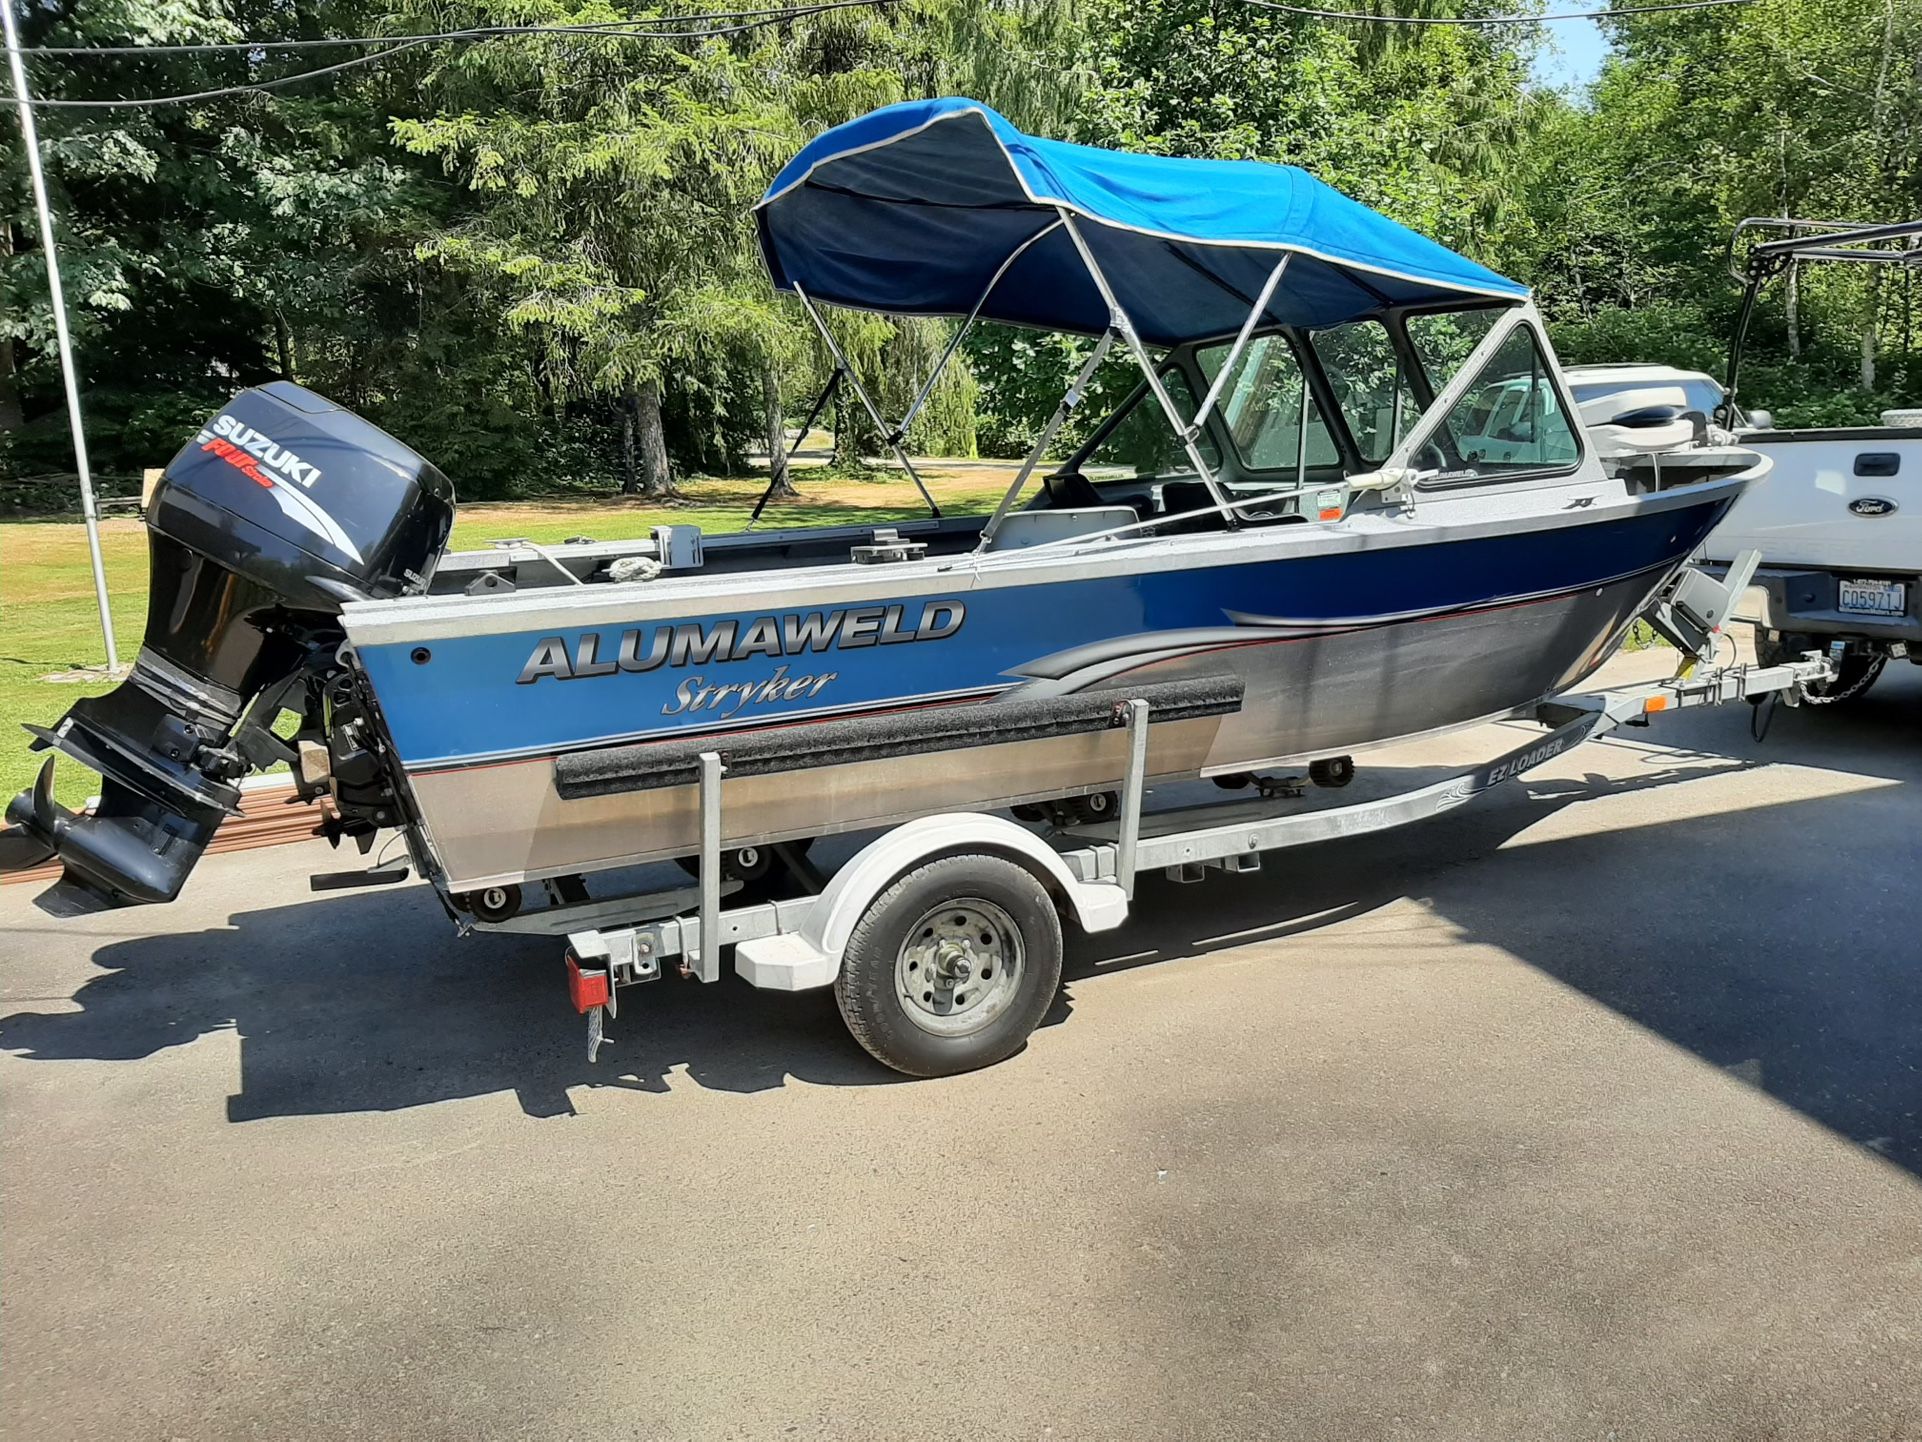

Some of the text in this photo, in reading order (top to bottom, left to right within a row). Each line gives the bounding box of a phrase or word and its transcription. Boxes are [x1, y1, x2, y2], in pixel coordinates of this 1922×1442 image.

[212, 414, 322, 489] SUZUKI
[1842, 589, 1903, 611] C05971J
[515, 600, 967, 685] ALUMAWELD
[660, 664, 838, 720] Stryker
[1487, 739, 1564, 785] EZ LOADER
